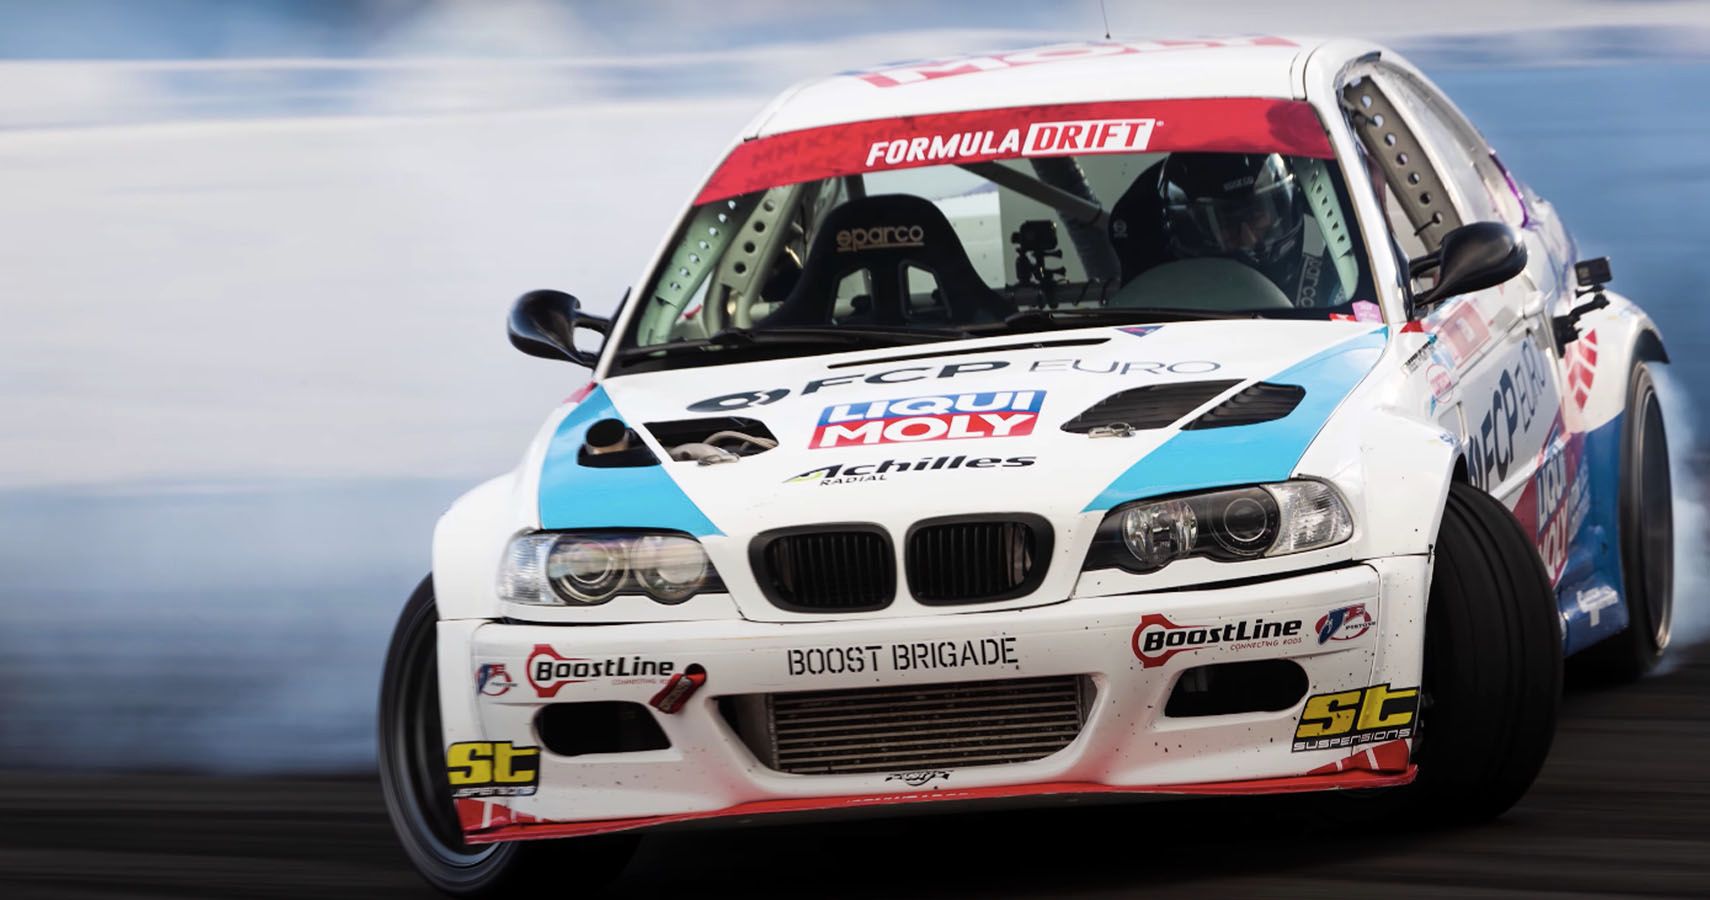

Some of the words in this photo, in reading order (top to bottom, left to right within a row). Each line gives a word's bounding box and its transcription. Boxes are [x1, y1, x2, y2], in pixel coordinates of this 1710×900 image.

[865, 127, 1020, 167] FORMULA
[1032, 121, 1147, 151] DRIFT
[800, 361, 1010, 397] FCP
[1028, 358, 1221, 376] EURO
[827, 391, 1036, 424] LIQUI
[819, 413, 1035, 448] MOLY
[785, 455, 1038, 483] Achilles
[820, 474, 887, 487] RADIAL
[787, 645, 883, 676] BOOST
[892, 637, 1019, 671] BRIGADE
[1230, 639, 1279, 652] CONNECTING
[1293, 728, 1412, 752] SUSPENSIONS
